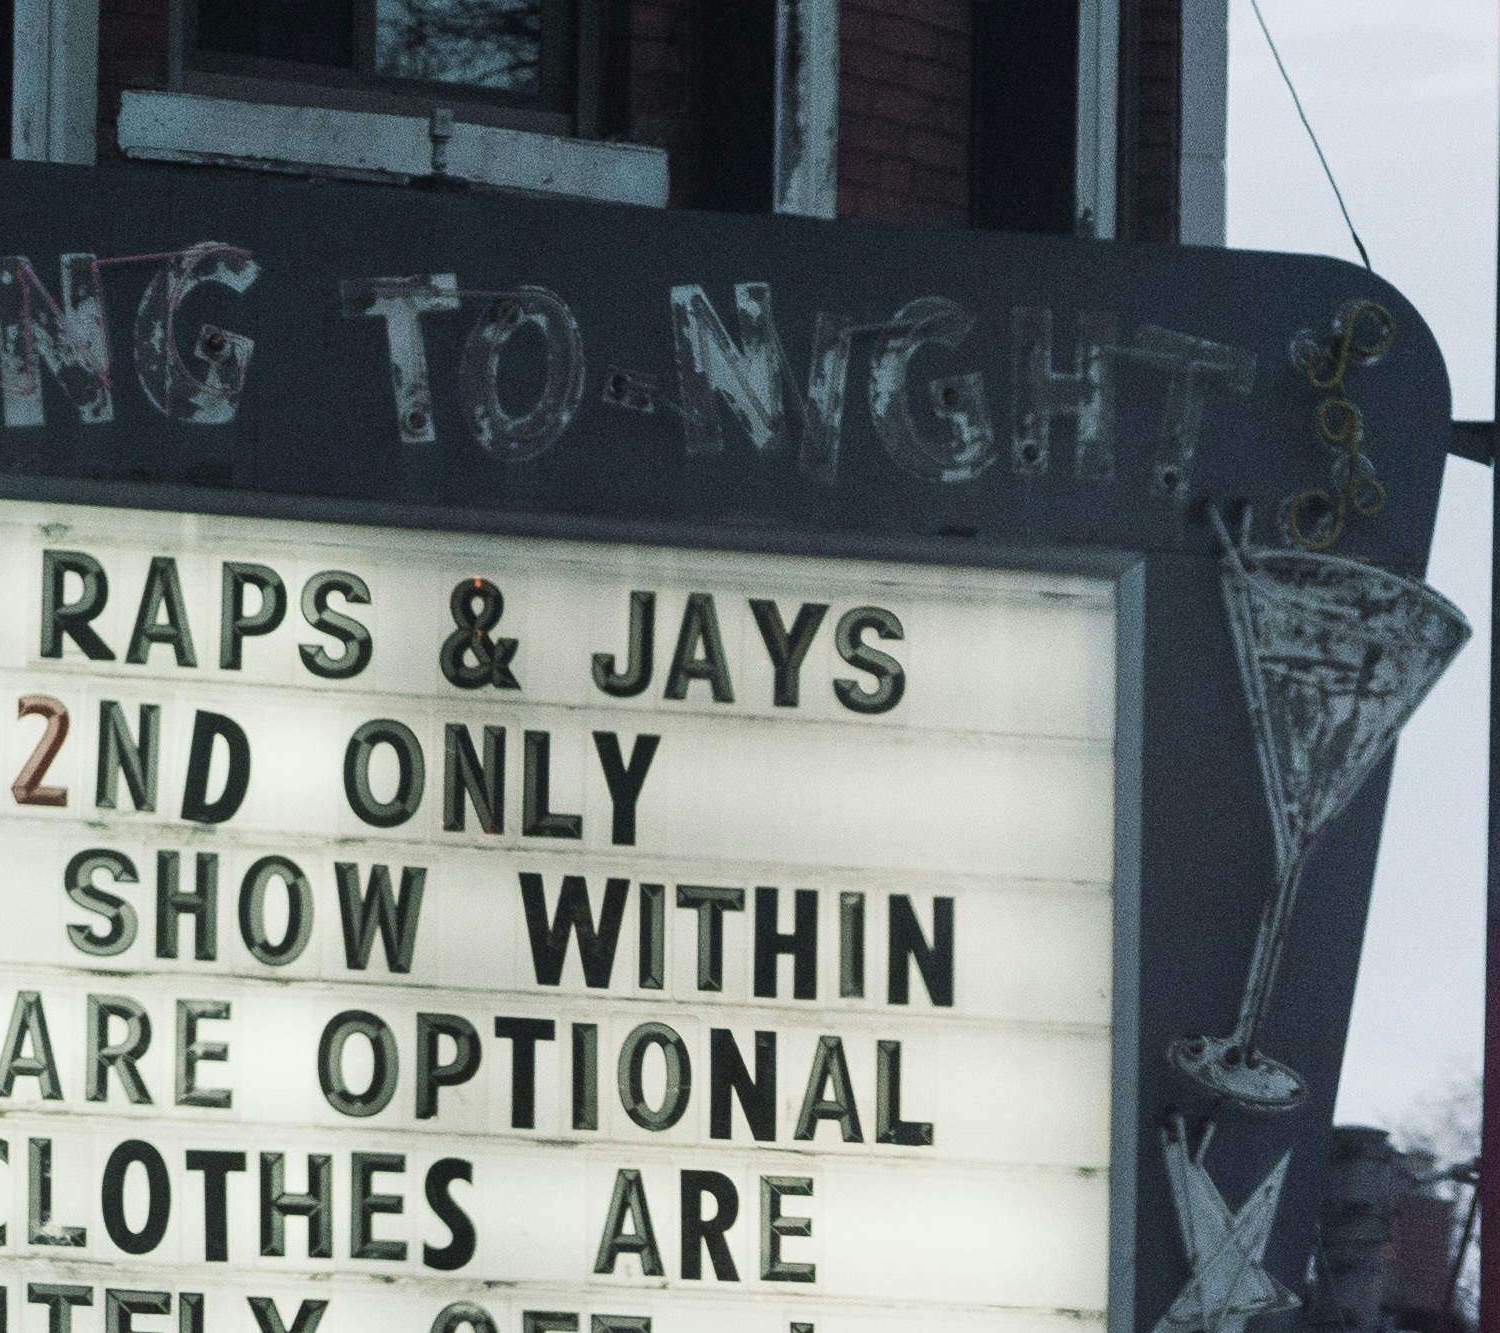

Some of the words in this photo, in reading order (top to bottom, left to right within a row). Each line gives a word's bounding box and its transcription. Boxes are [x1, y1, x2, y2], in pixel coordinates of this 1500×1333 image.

[39, 548, 374, 681] RAPS
[437, 574, 522, 693] &
[590, 590, 907, 715] JAYS
[11, 694, 252, 824] 2ND
[341, 717, 661, 846] ONLY
[62, 847, 428, 974] SHOW
[516, 871, 956, 1008] WITHIN
[315, 1008, 935, 1146] OPTIONAL
[592, 1167, 817, 1283] ARE
